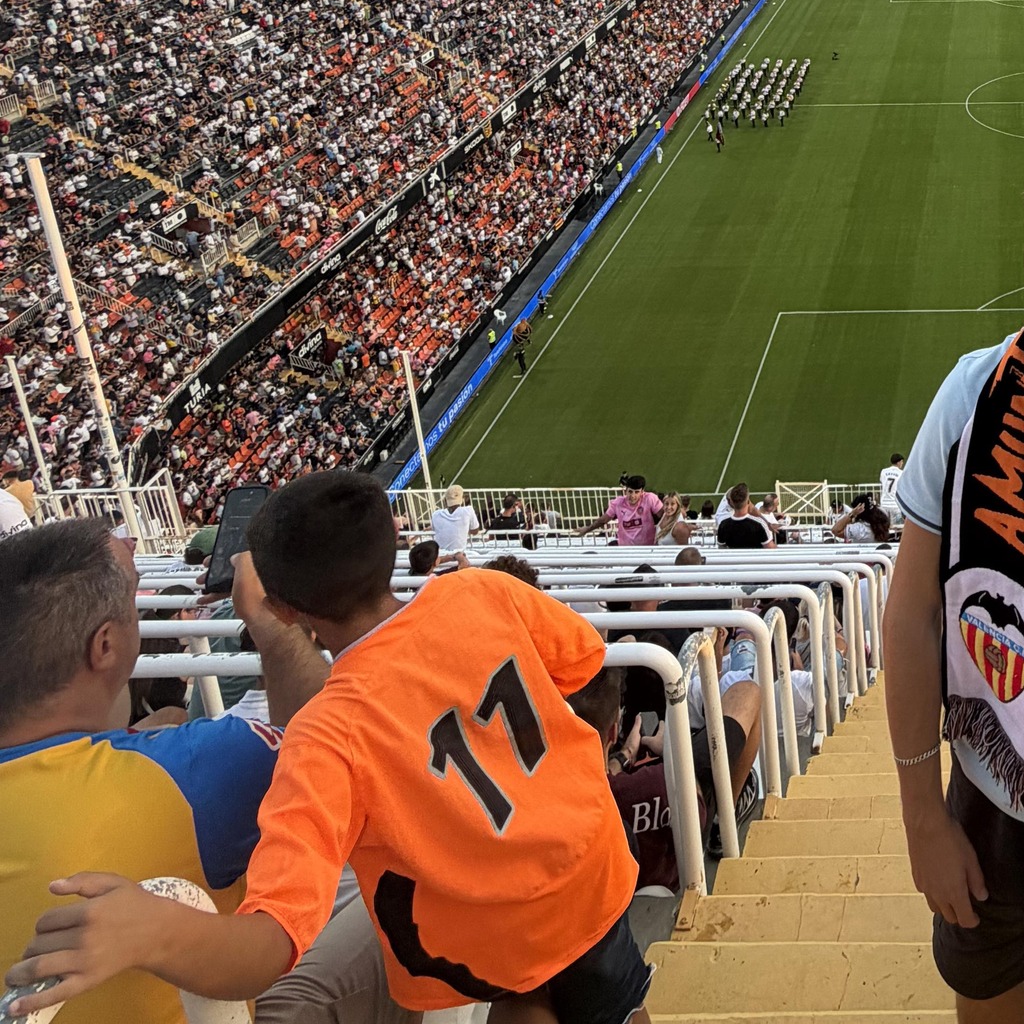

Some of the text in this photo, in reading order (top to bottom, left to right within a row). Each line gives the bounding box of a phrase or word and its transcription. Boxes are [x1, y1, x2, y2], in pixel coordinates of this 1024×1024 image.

[463, 133, 485, 154] SKODA
[321, 253, 341, 274] divina
[298, 331, 322, 358] divina
[183, 383, 212, 414] TURIA
[438, 418, 448, 433] tu
[448, 383, 473, 424] pasión
[887, 477, 896, 493] 7
[966, 613, 1011, 647] VALENCIA
[427, 654, 549, 837] 11
[632, 796, 672, 834] Bla
